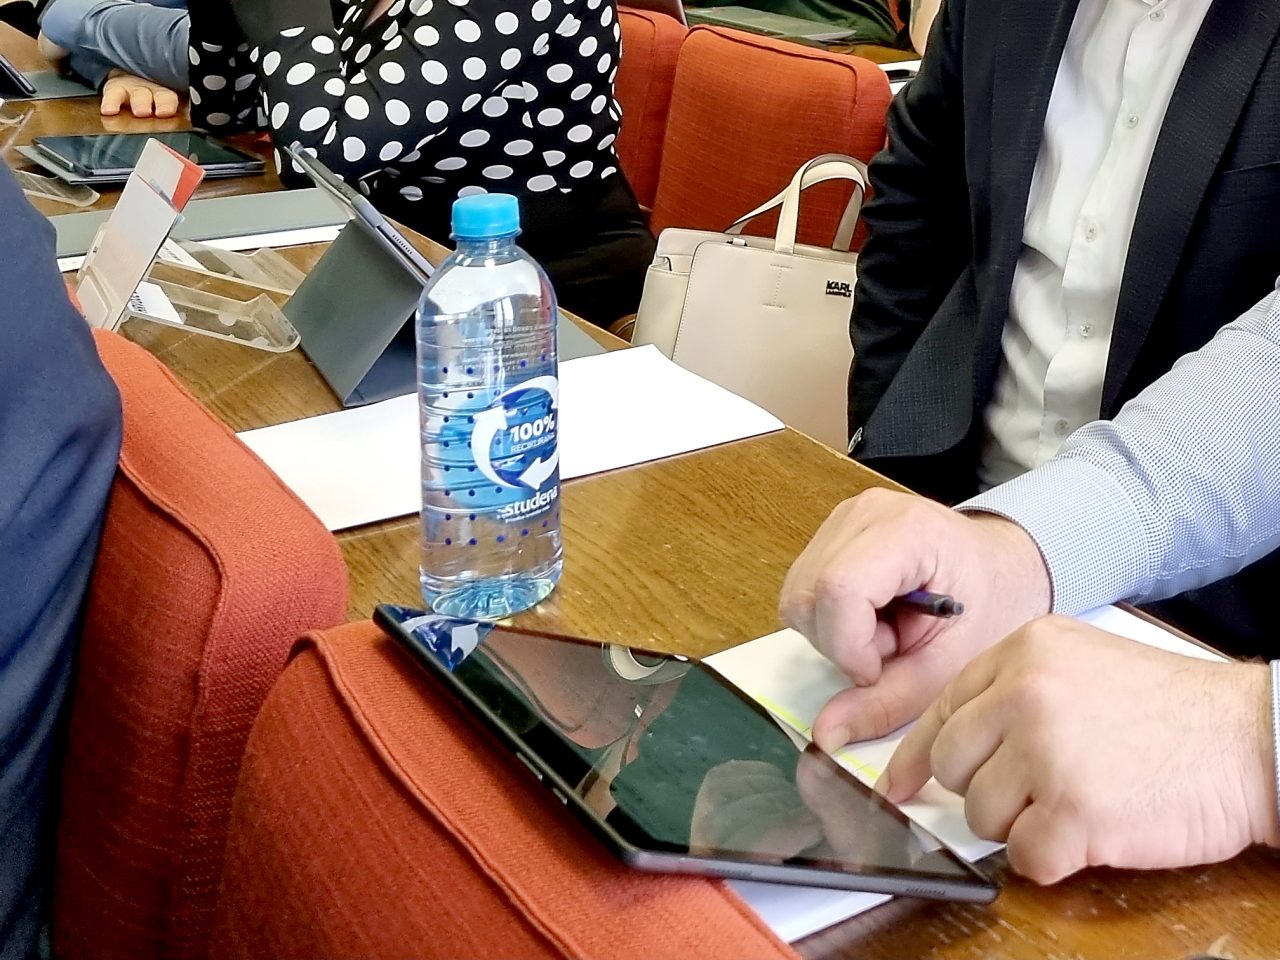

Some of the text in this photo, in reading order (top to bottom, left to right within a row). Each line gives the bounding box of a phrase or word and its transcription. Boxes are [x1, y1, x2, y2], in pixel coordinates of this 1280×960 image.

[826, 280, 852, 292] KARL
[510, 413, 555, 442] 100%
[504, 485, 558, 516] studena
